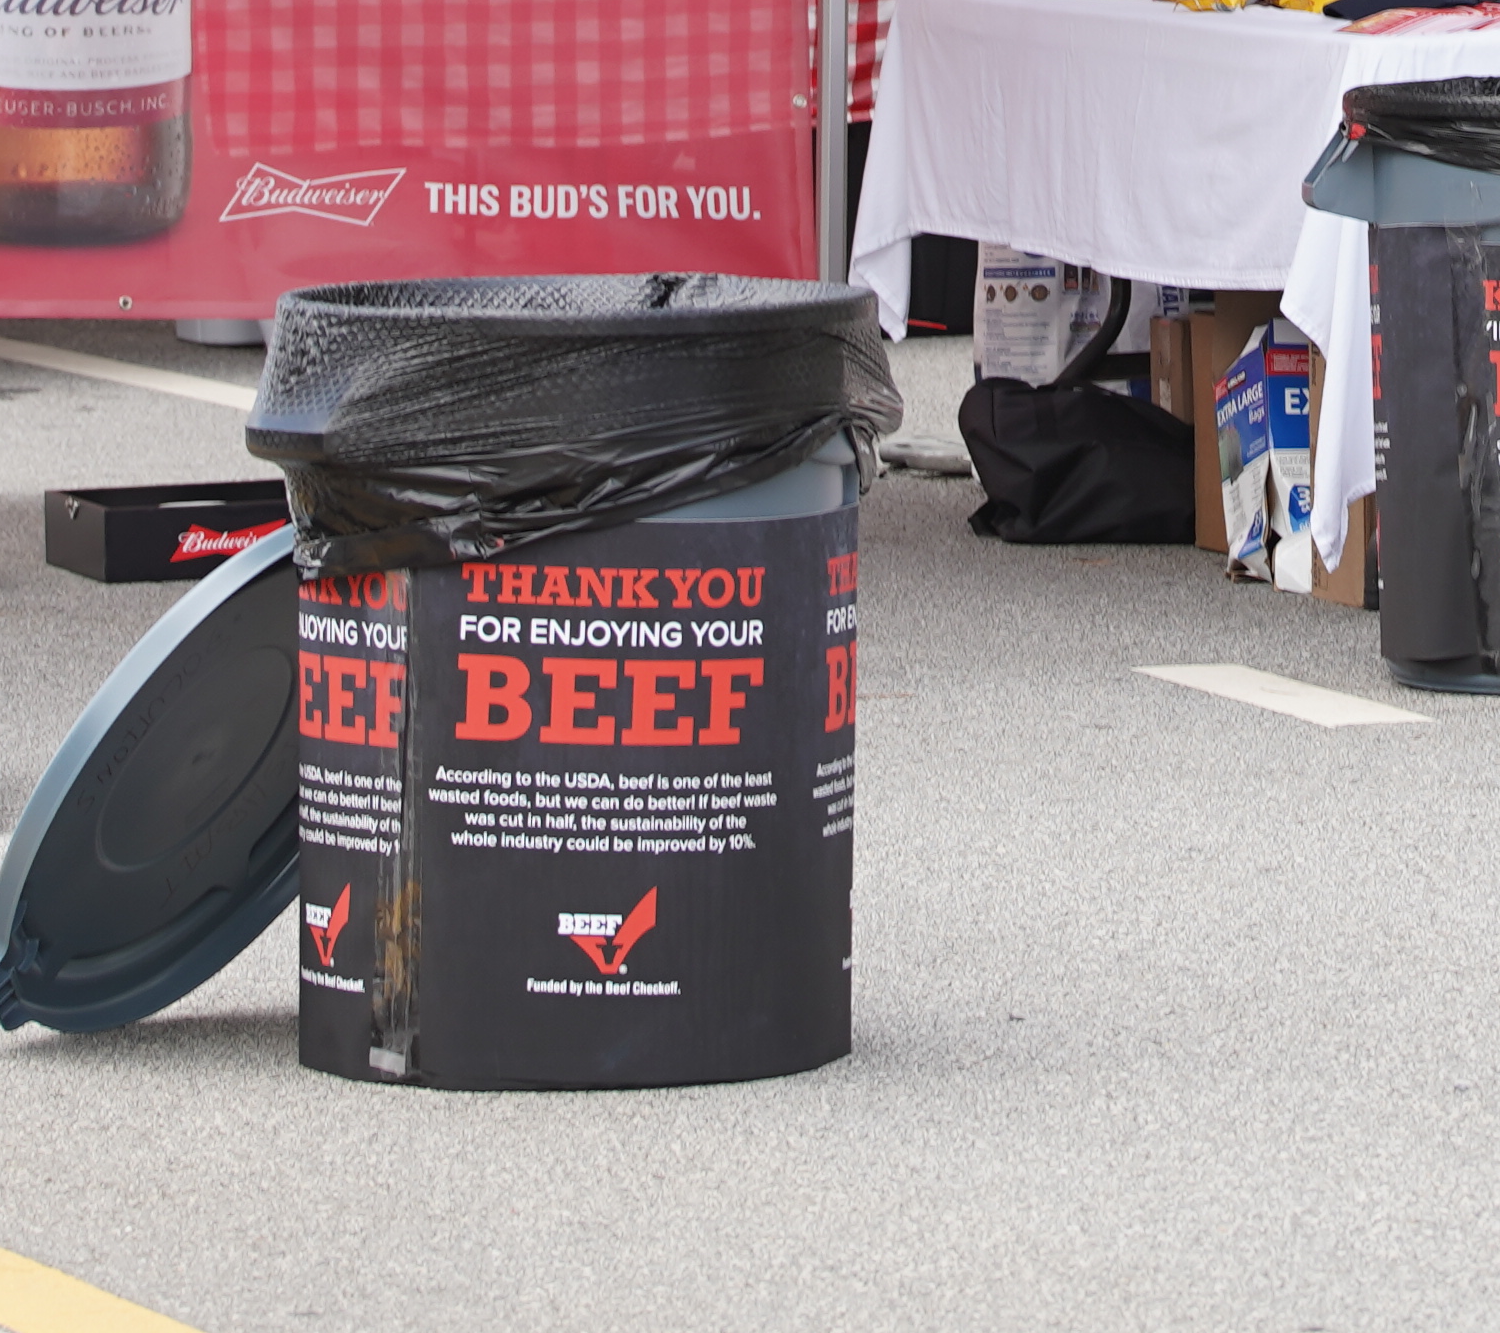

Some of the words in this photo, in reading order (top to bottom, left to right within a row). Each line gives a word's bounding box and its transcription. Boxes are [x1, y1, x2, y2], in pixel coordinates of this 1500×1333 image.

[236, 175, 388, 208] Budweiser
[424, 181, 500, 217] THIS
[509, 184, 609, 220] BUD'S
[617, 184, 679, 219] FOR
[686, 185, 761, 221] YOU.
[1238, 380, 1264, 411] LARGE
[461, 563, 660, 609] THANK
[664, 566, 766, 609] YOU
[459, 614, 522, 643] FOR
[530, 617, 683, 648] ENJOYING
[690, 619, 764, 648] YOUR
[455, 652, 765, 747] BEEF
[435, 765, 512, 789] According
[515, 770, 532, 787] to
[534, 771, 561, 788] the
[564, 771, 615, 791] USDA,
[618, 773, 655, 790] beef
[656, 773, 670, 790] is
[672, 776, 701, 790] one
[703, 772, 719, 789] of
[720, 772, 743, 789] the
[744, 771, 773, 787] least
[428, 788, 480, 805] wasted
[484, 788, 531, 809] foods,
[535, 791, 561, 809] but
[565, 792, 587, 810] we
[592, 792, 619, 810] can
[623, 791, 644, 810] do
[647, 791, 695, 810] better!
[698, 793, 709, 810] If
[710, 792, 742, 810] beef
[743, 791, 778, 808] waste
[465, 812, 495, 827] was
[498, 812, 524, 828] cut
[527, 811, 542, 829] in
[545, 812, 578, 832] half,
[580, 814, 607, 831] the
[610, 814, 707, 834] sustainability
[708, 813, 724, 831] of
[725, 813, 747, 830] the
[451, 830, 497, 847] whole
[500, 831, 564, 854] industry
[566, 835, 610, 852] could
[612, 835, 634, 853] be
[637, 835, 706, 855] improved
[708, 835, 727, 855] by
[557, 913, 622, 936] BEEF
